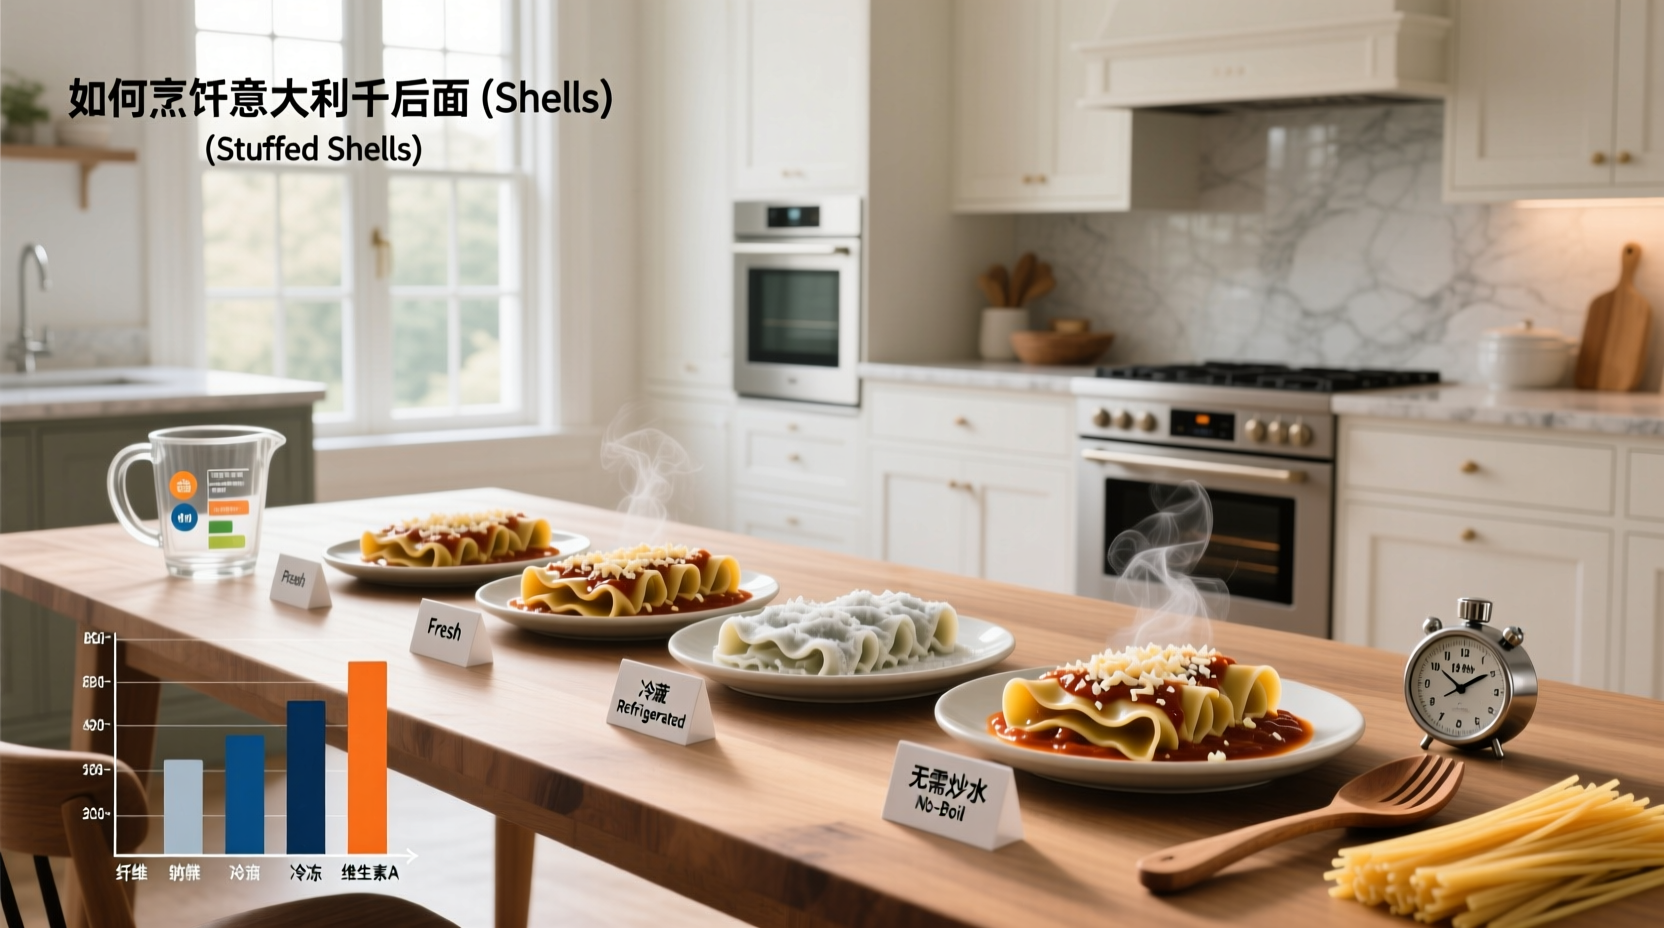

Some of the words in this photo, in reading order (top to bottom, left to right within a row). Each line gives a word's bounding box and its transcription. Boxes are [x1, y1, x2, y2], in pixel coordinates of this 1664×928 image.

[427, 617, 462, 642] Fresh
[616, 698, 687, 729] Refrigerated
[908, 764, 988, 804] 无需炒水
[914, 794, 966, 822] No-Boil
